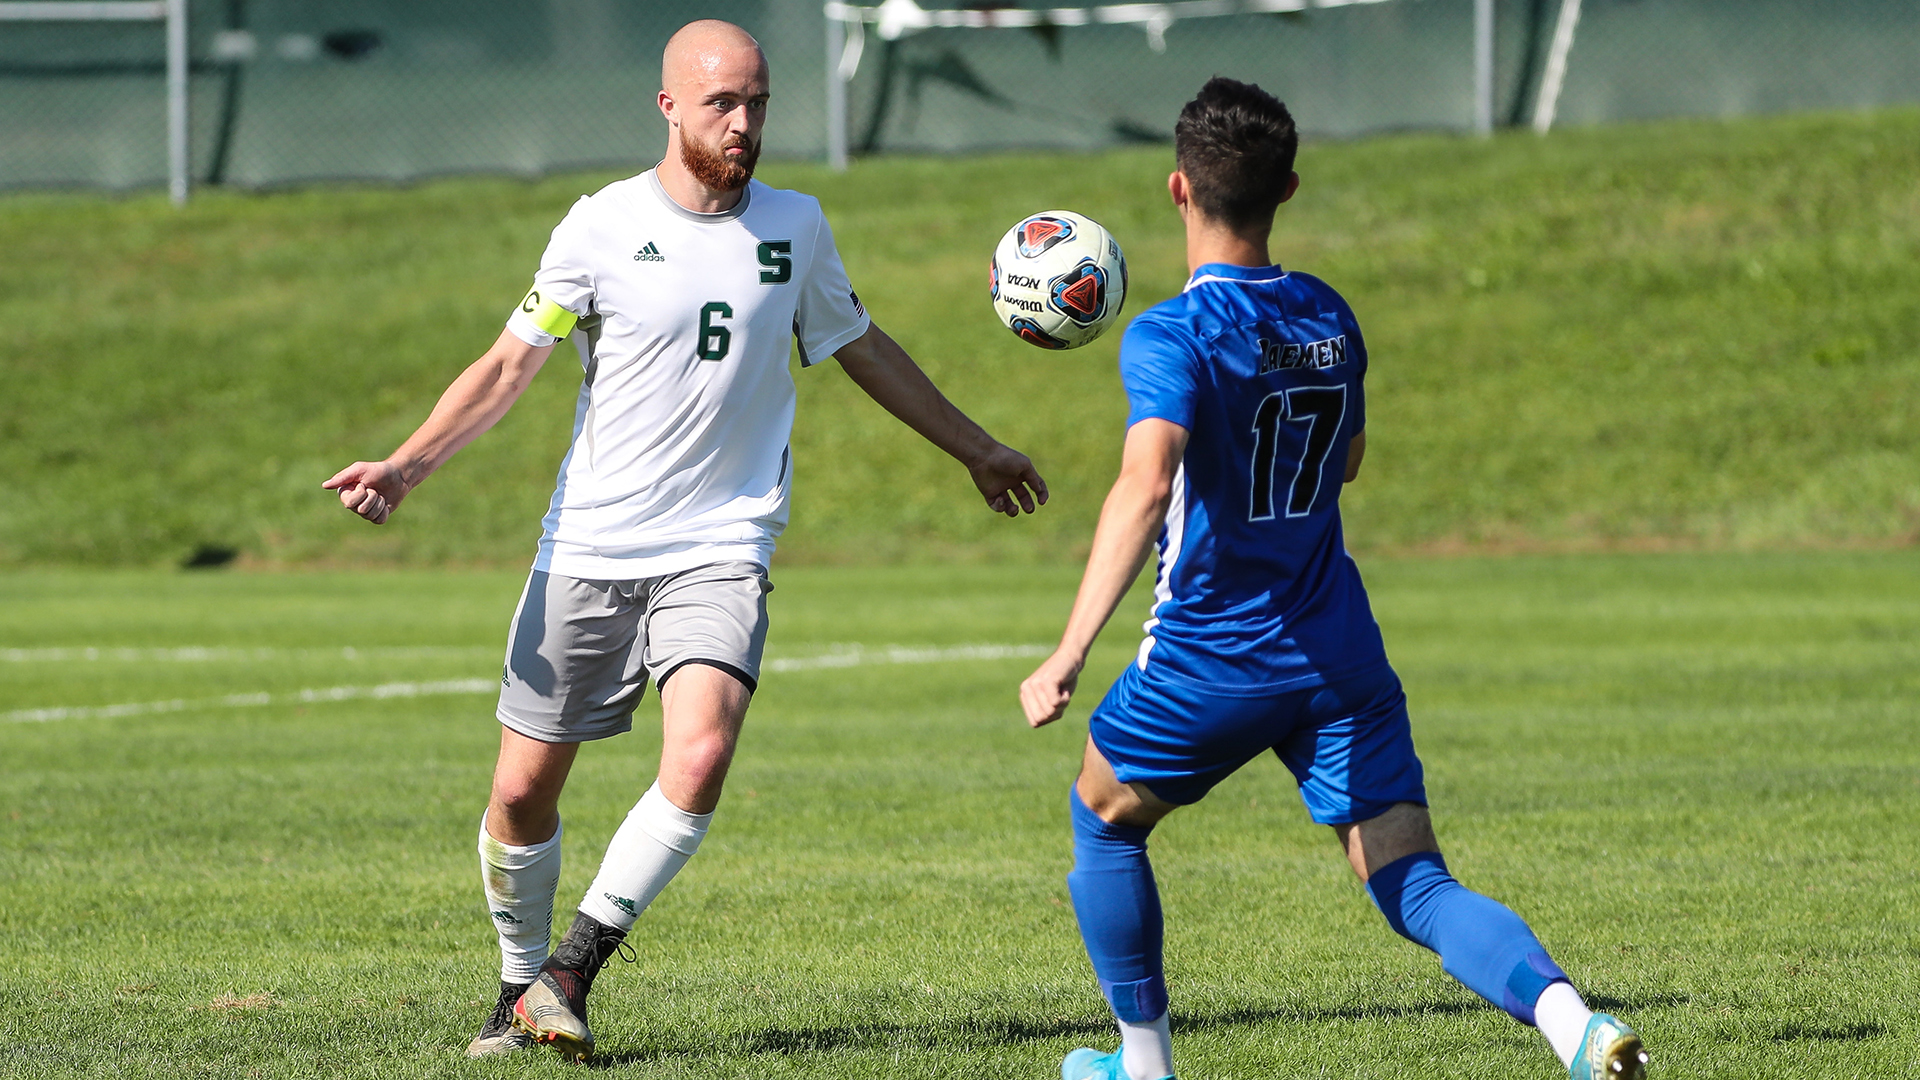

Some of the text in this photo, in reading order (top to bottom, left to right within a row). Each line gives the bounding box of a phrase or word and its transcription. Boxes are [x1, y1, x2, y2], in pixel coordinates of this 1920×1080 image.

[633, 253, 666, 262] adidas
[756, 239, 792, 285] S
[1007, 273, 1040, 290] NCAA
[522, 290, 540, 313] C
[1003, 294, 1043, 313] Wilson
[697, 301, 734, 362] 6
[1248, 383, 1347, 522] 17
